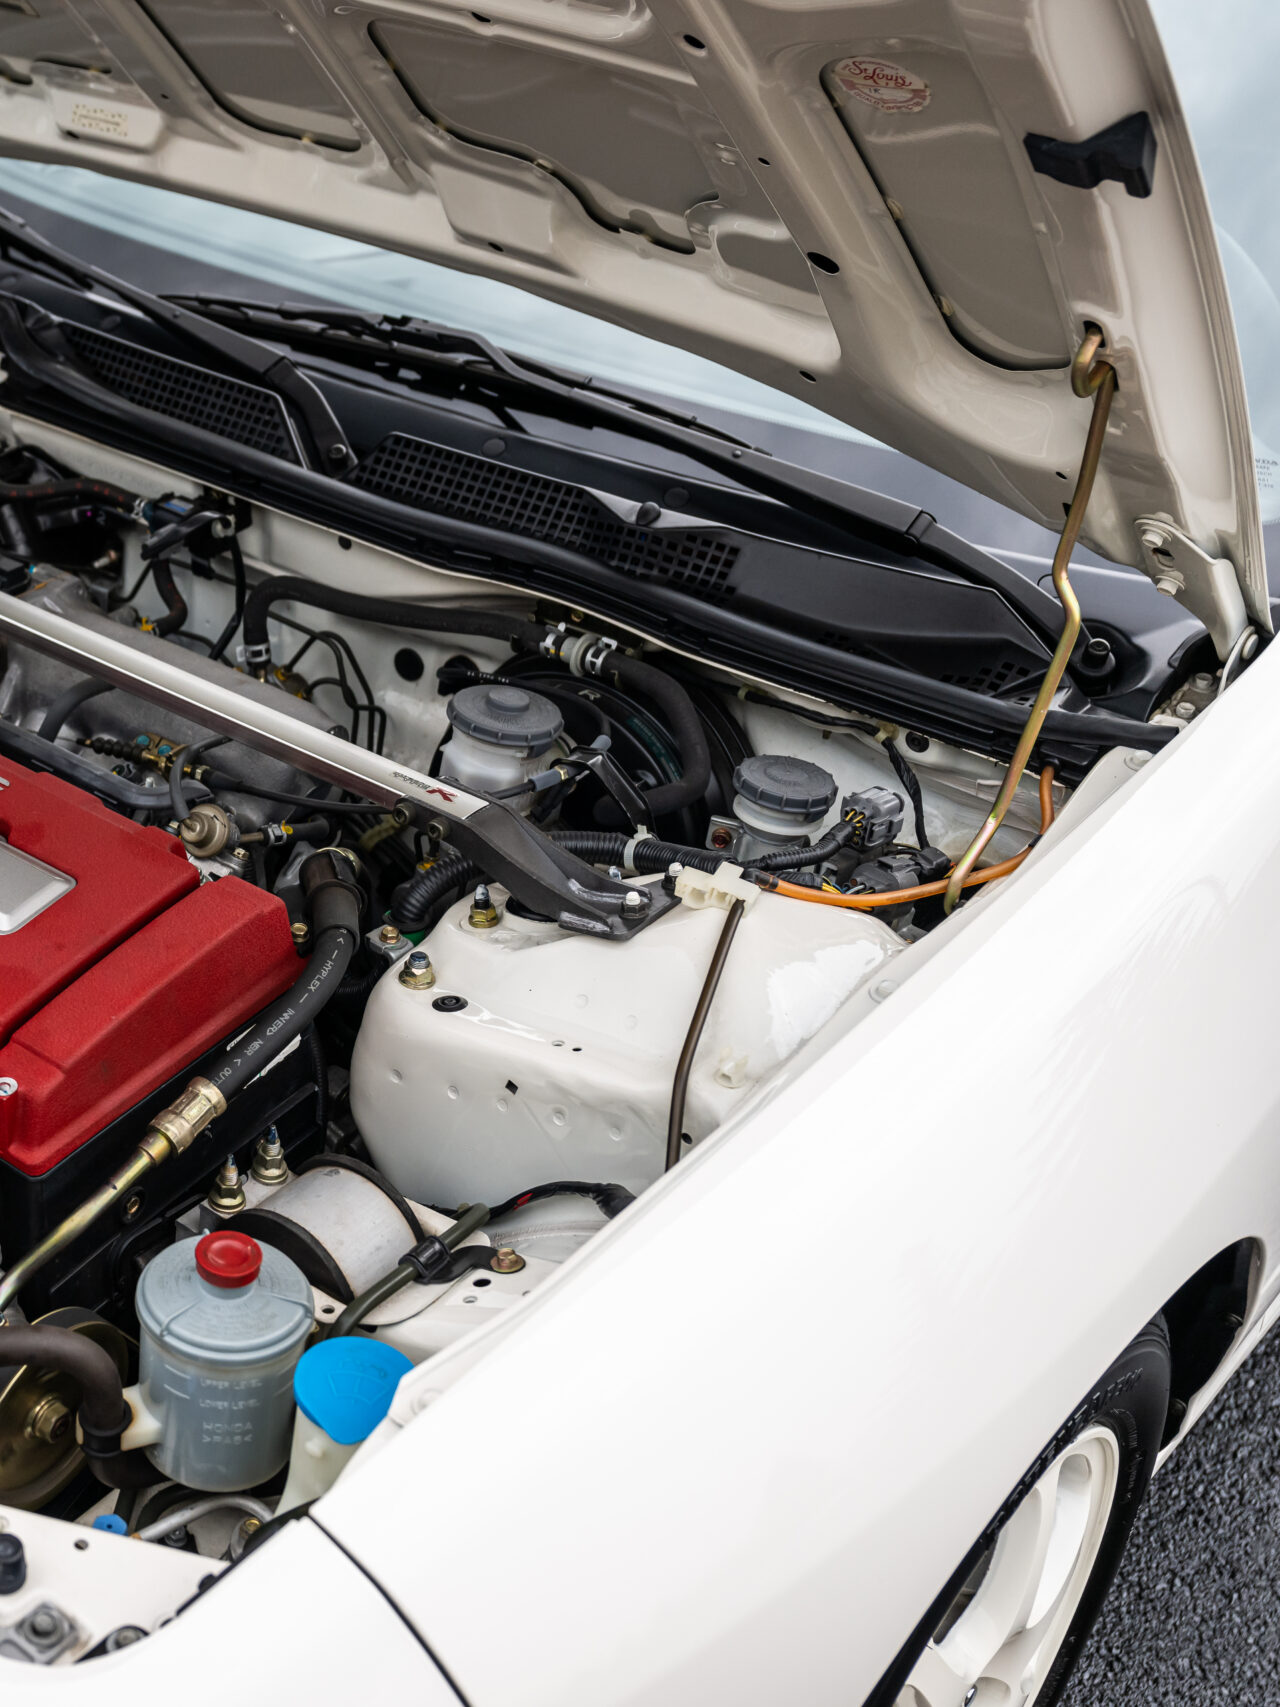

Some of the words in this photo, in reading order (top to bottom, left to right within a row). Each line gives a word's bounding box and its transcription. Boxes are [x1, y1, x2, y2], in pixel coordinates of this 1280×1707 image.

[863, 66, 913, 88] Louis
[306, 959, 335, 993] HYPLEX
[243, 1037, 264, 1057] NBR
[199, 1377, 229, 1389] UPPER
[232, 1378, 264, 1390] LEVEL
[199, 1398, 229, 1410] LOWER
[231, 1399, 263, 1410] LEVEL
[202, 1421, 254, 1433] HONDA
